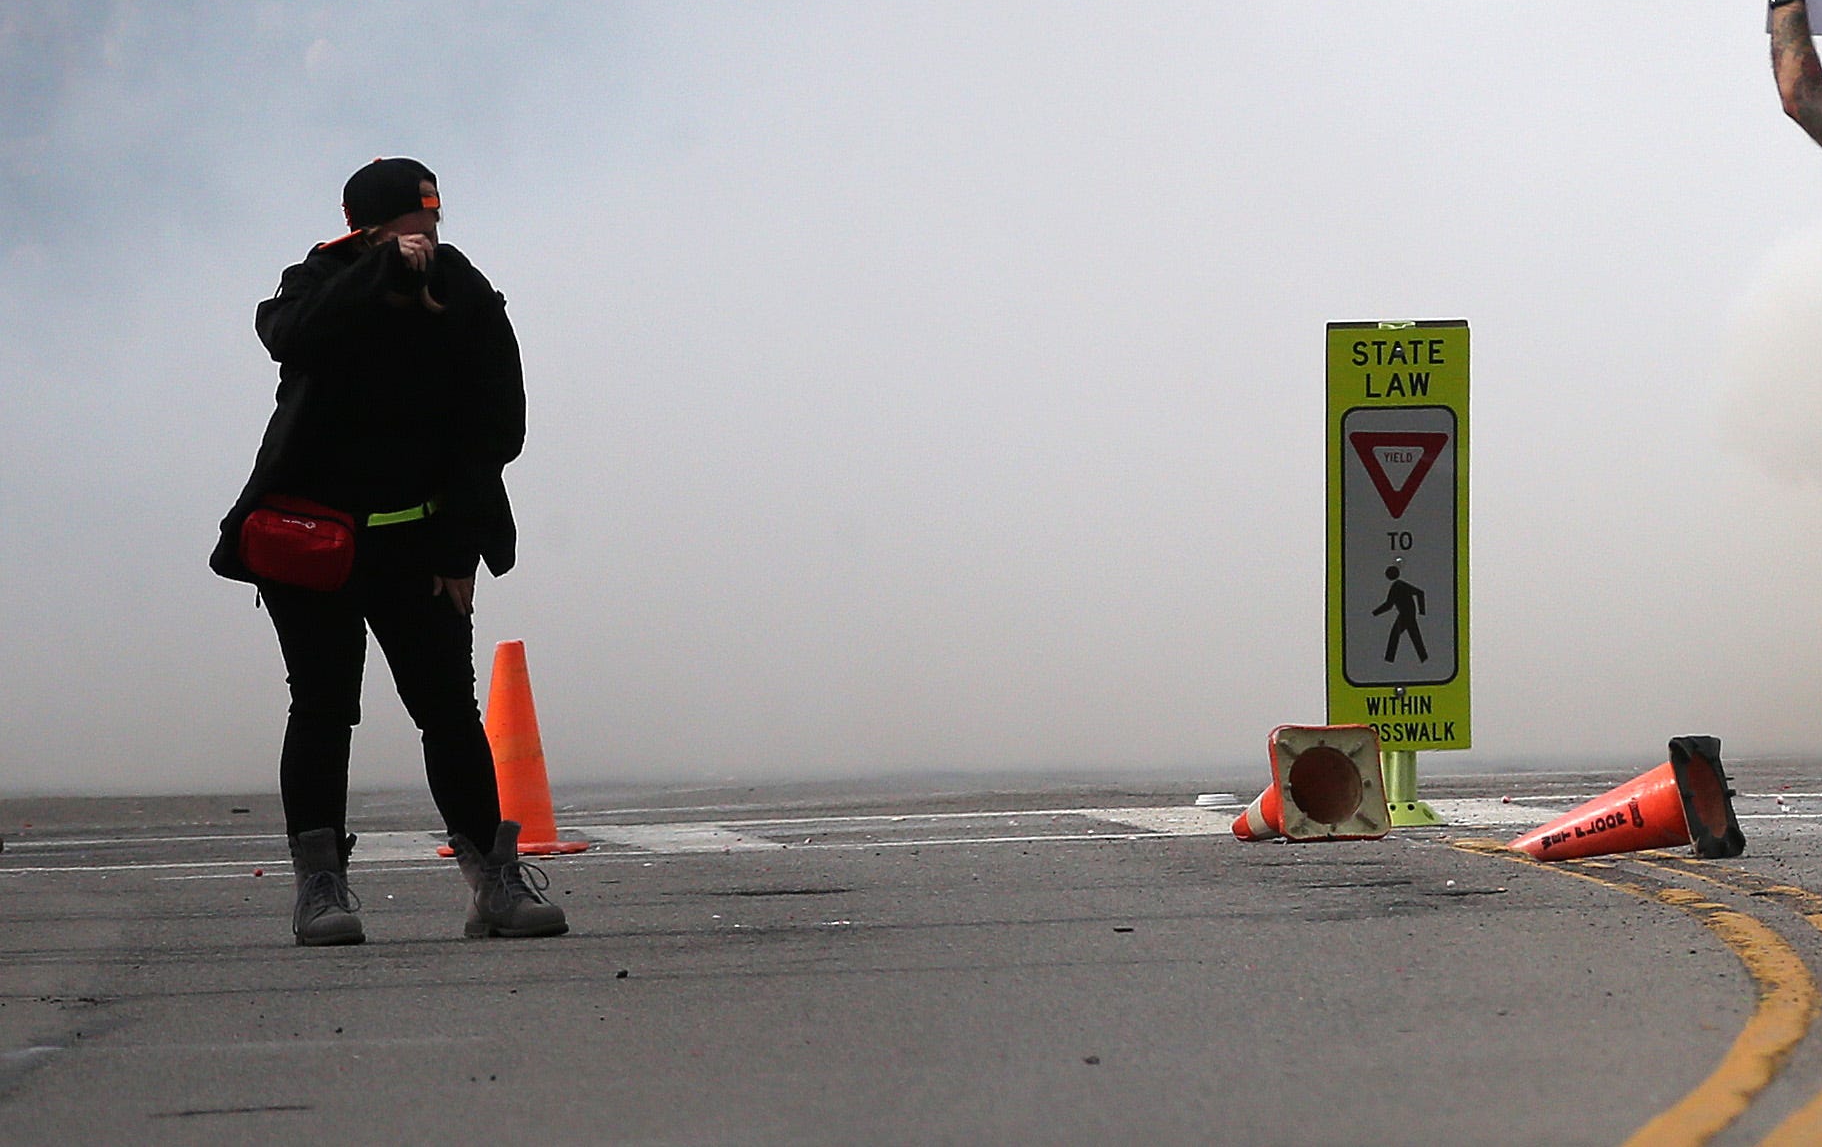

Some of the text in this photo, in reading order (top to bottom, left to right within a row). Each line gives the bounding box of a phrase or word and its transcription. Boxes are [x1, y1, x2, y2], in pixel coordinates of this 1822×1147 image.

[1351, 339, 1445, 366] STATE
[1365, 372, 1431, 398] LAW
[1383, 452, 1413, 463] YIELD
[1387, 532, 1414, 551] TO
[1366, 695, 1433, 716] WITHIN
